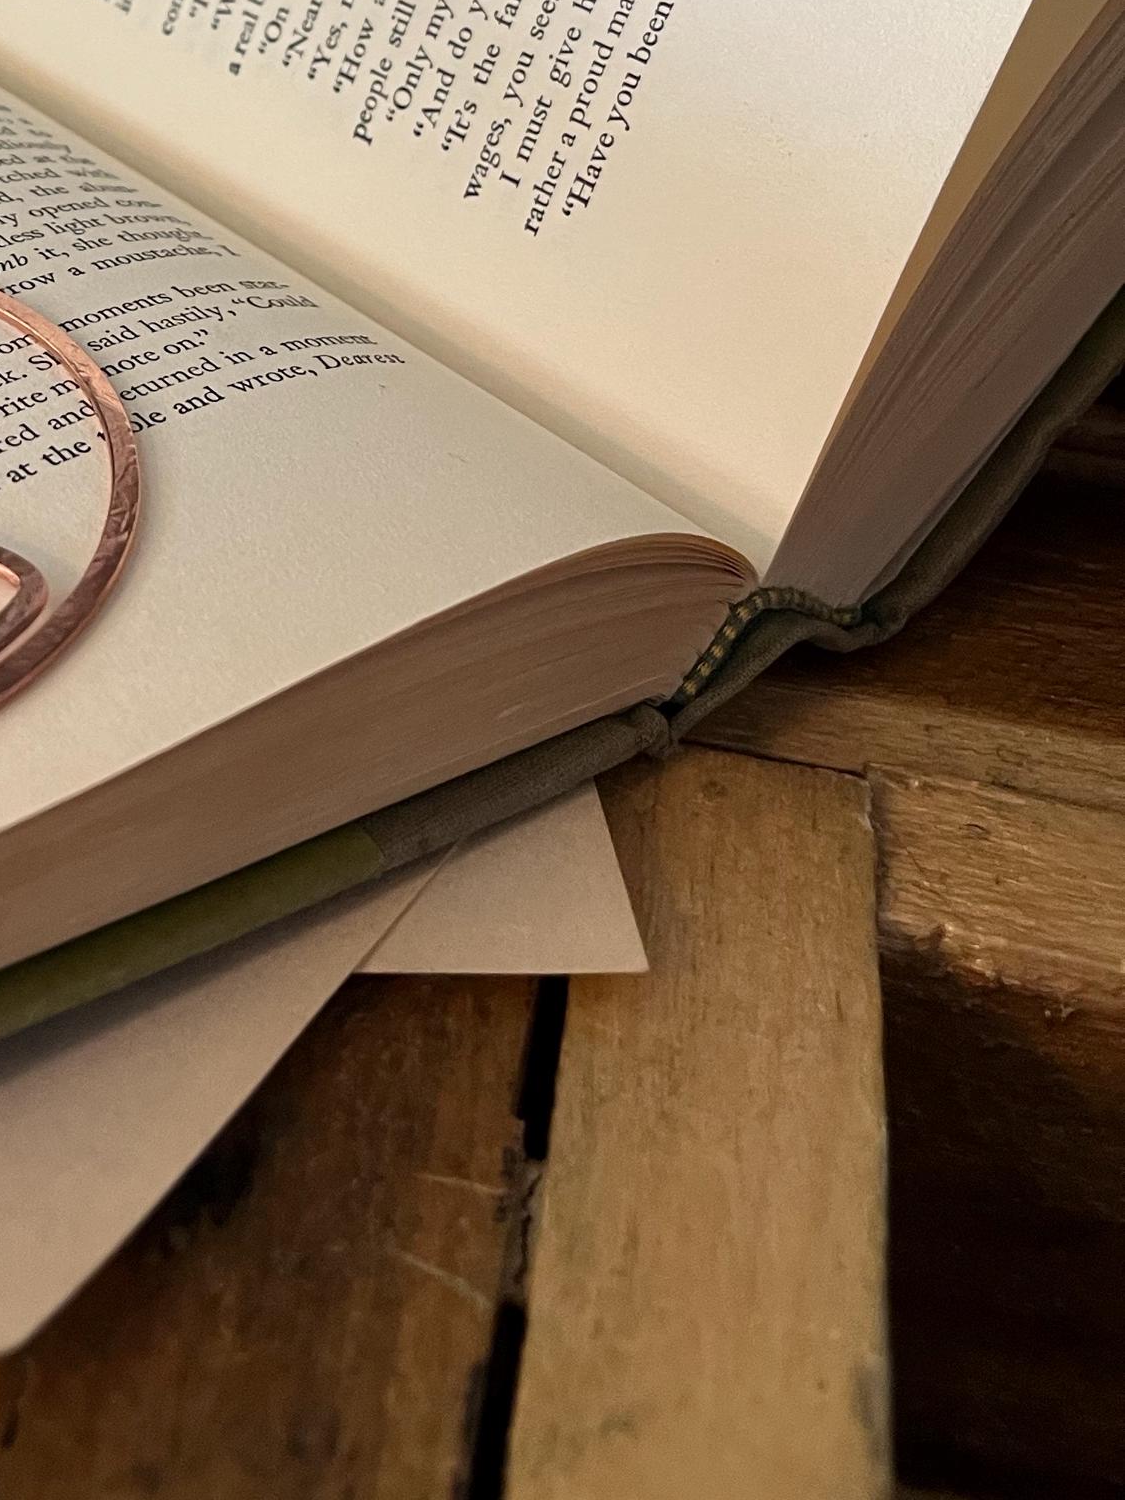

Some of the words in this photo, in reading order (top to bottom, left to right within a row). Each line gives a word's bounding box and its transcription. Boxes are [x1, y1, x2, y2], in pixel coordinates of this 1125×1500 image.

[307, 21, 347, 79] “Yes,
[332, 17, 373, 93] “How
[385, 44, 433, 121] “Only
[413, 67, 455, 137] “And
[446, 26, 472, 59] do
[440, 99, 477, 151] “It’s
[472, 43, 500, 84] the
[568, 39, 614, 130] proud
[463, 117, 512, 198] wages,
[502, 51, 534, 108] you
[498, 169, 521, 188] I
[516, 94, 552, 162] must
[548, 26, 581, 88] give
[561, 132, 614, 216] “Have
[606, 72, 641, 131] you
[625, 1, 674, 65] been
[561, 132, 576, 147] a
[523, 150, 566, 236] rather
[47, 401, 98, 432] and
[120, 356, 225, 401] eturned
[218, 351, 256, 365] in
[259, 343, 278, 359] a
[282, 334, 377, 352] moment
[100, 347, 164, 378] note
[162, 328, 208, 354] on.”
[5, 462, 38, 483] at
[40, 441, 91, 465] the
[172, 385, 225, 414] and
[226, 365, 317, 392] wrote,
[316, 353, 406, 370] Dearest
